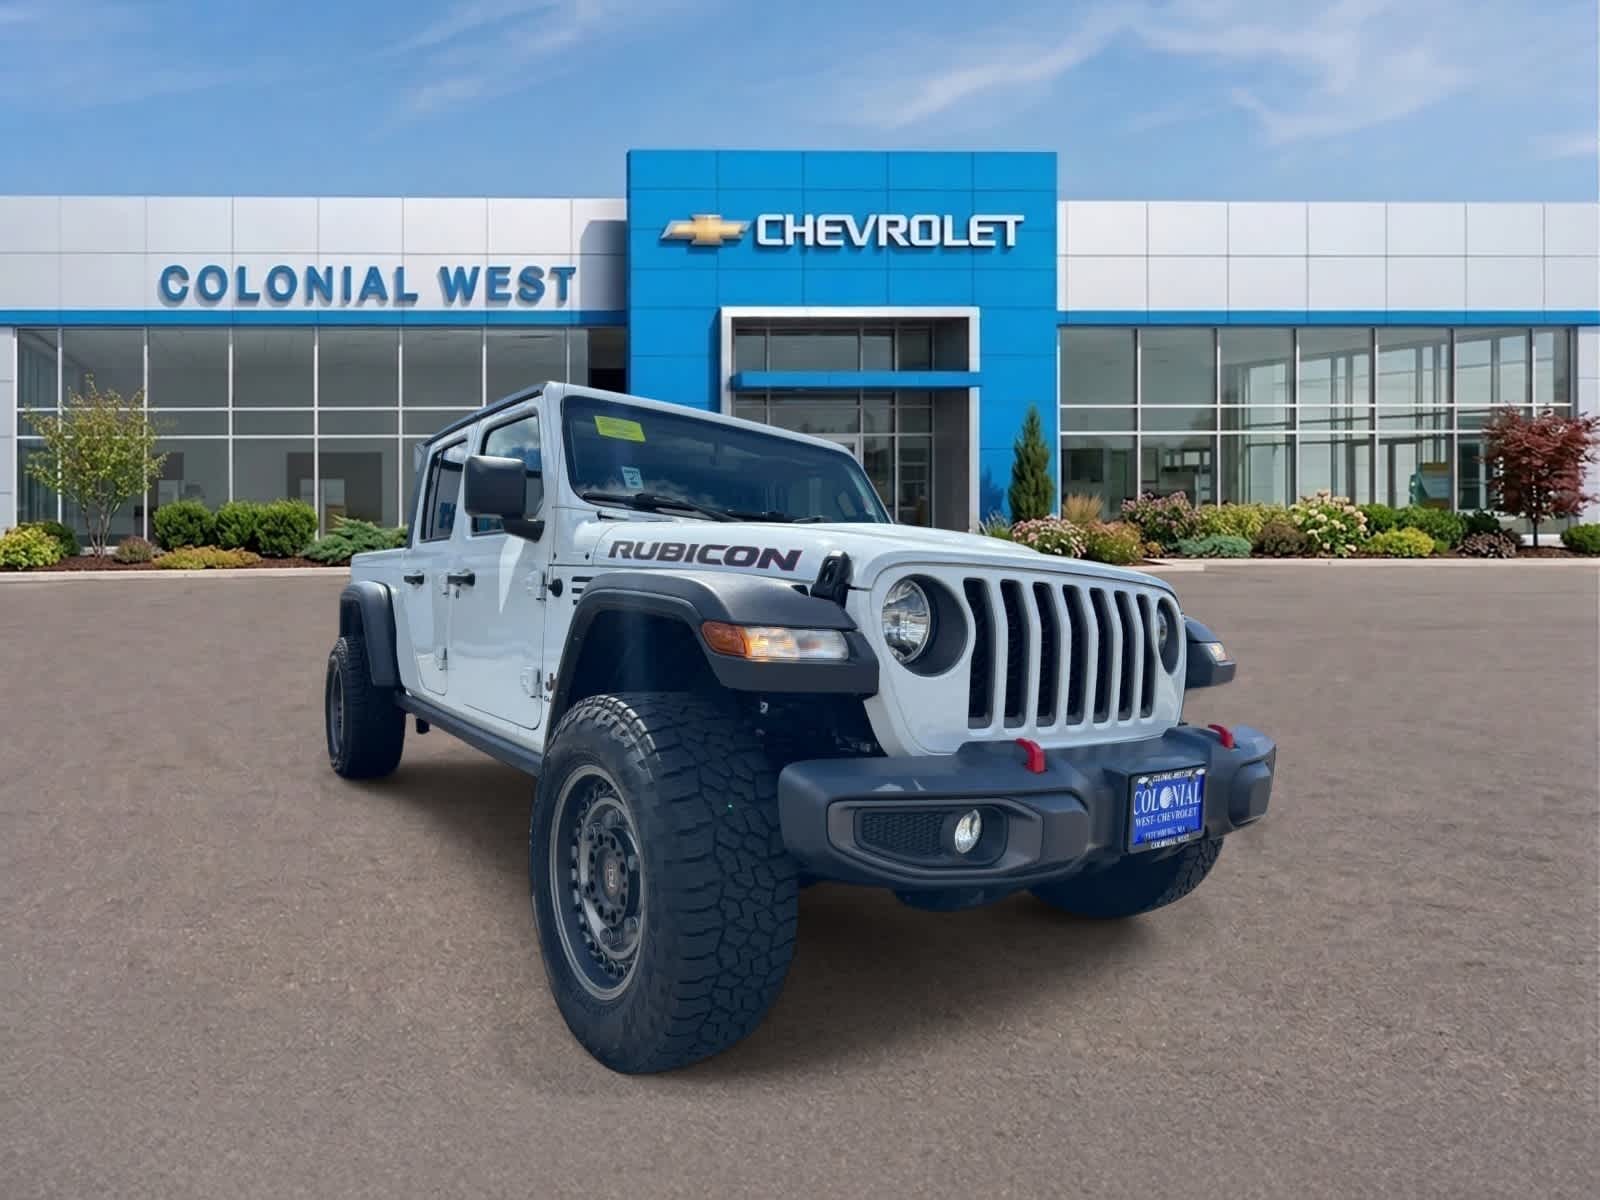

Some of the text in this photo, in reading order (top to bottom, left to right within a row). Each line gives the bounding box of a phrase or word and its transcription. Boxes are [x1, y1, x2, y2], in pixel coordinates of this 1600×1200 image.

[756, 213, 1025, 247] CHEVROLET
[159, 264, 577, 304] COLONIAL WEST
[607, 540, 804, 572] RUBICON
[1133, 782, 1201, 816] COLONIAL
[1156, 806, 1198, 823] CHEVROLET
